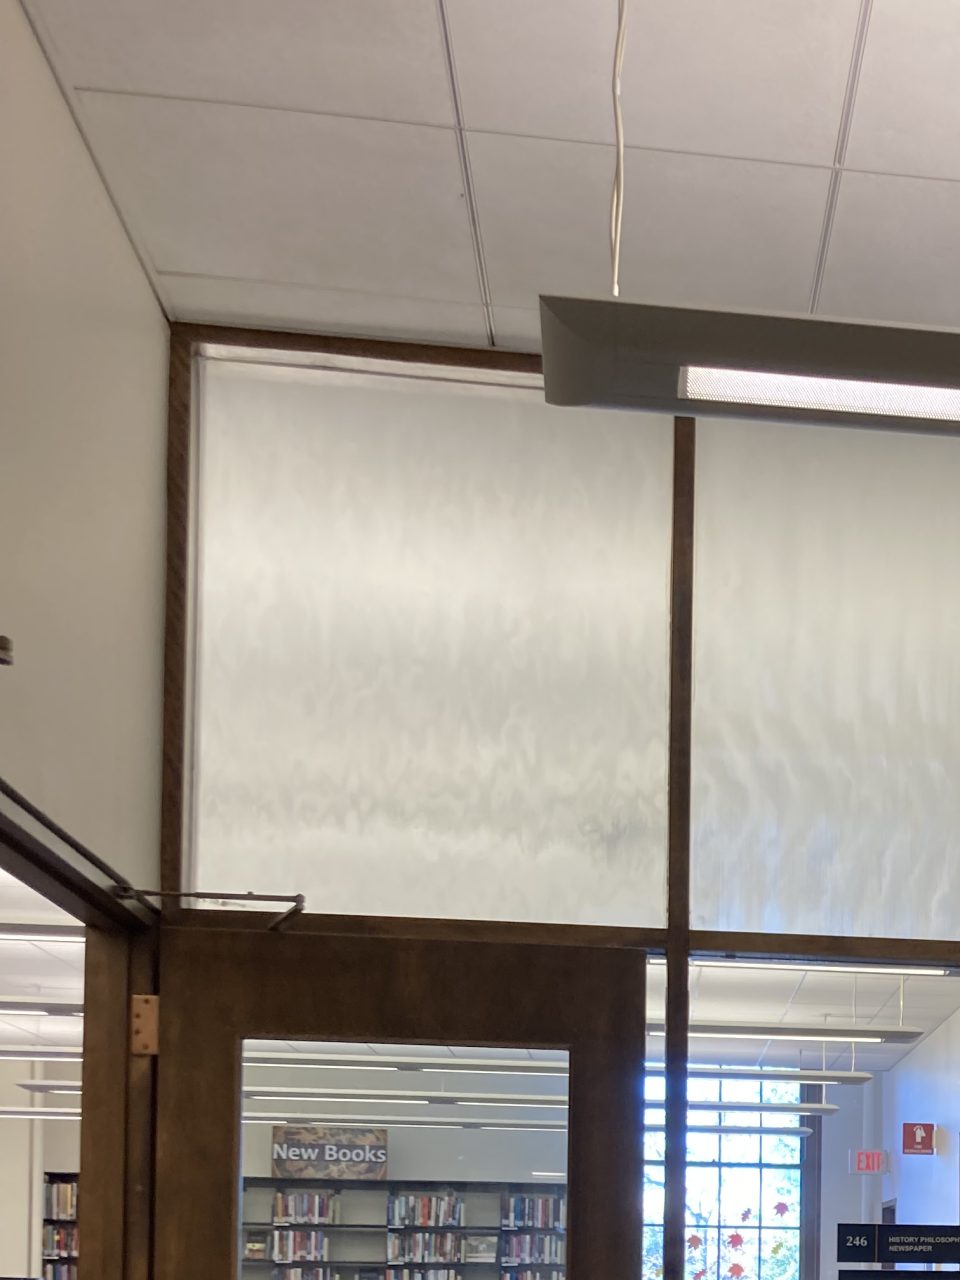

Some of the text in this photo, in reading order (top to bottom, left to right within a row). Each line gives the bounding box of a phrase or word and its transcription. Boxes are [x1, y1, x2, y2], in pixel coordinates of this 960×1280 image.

[273, 1143, 387, 1162] New Books
[856, 1151, 882, 1171] EXIT
[846, 1236, 868, 1247] 246
